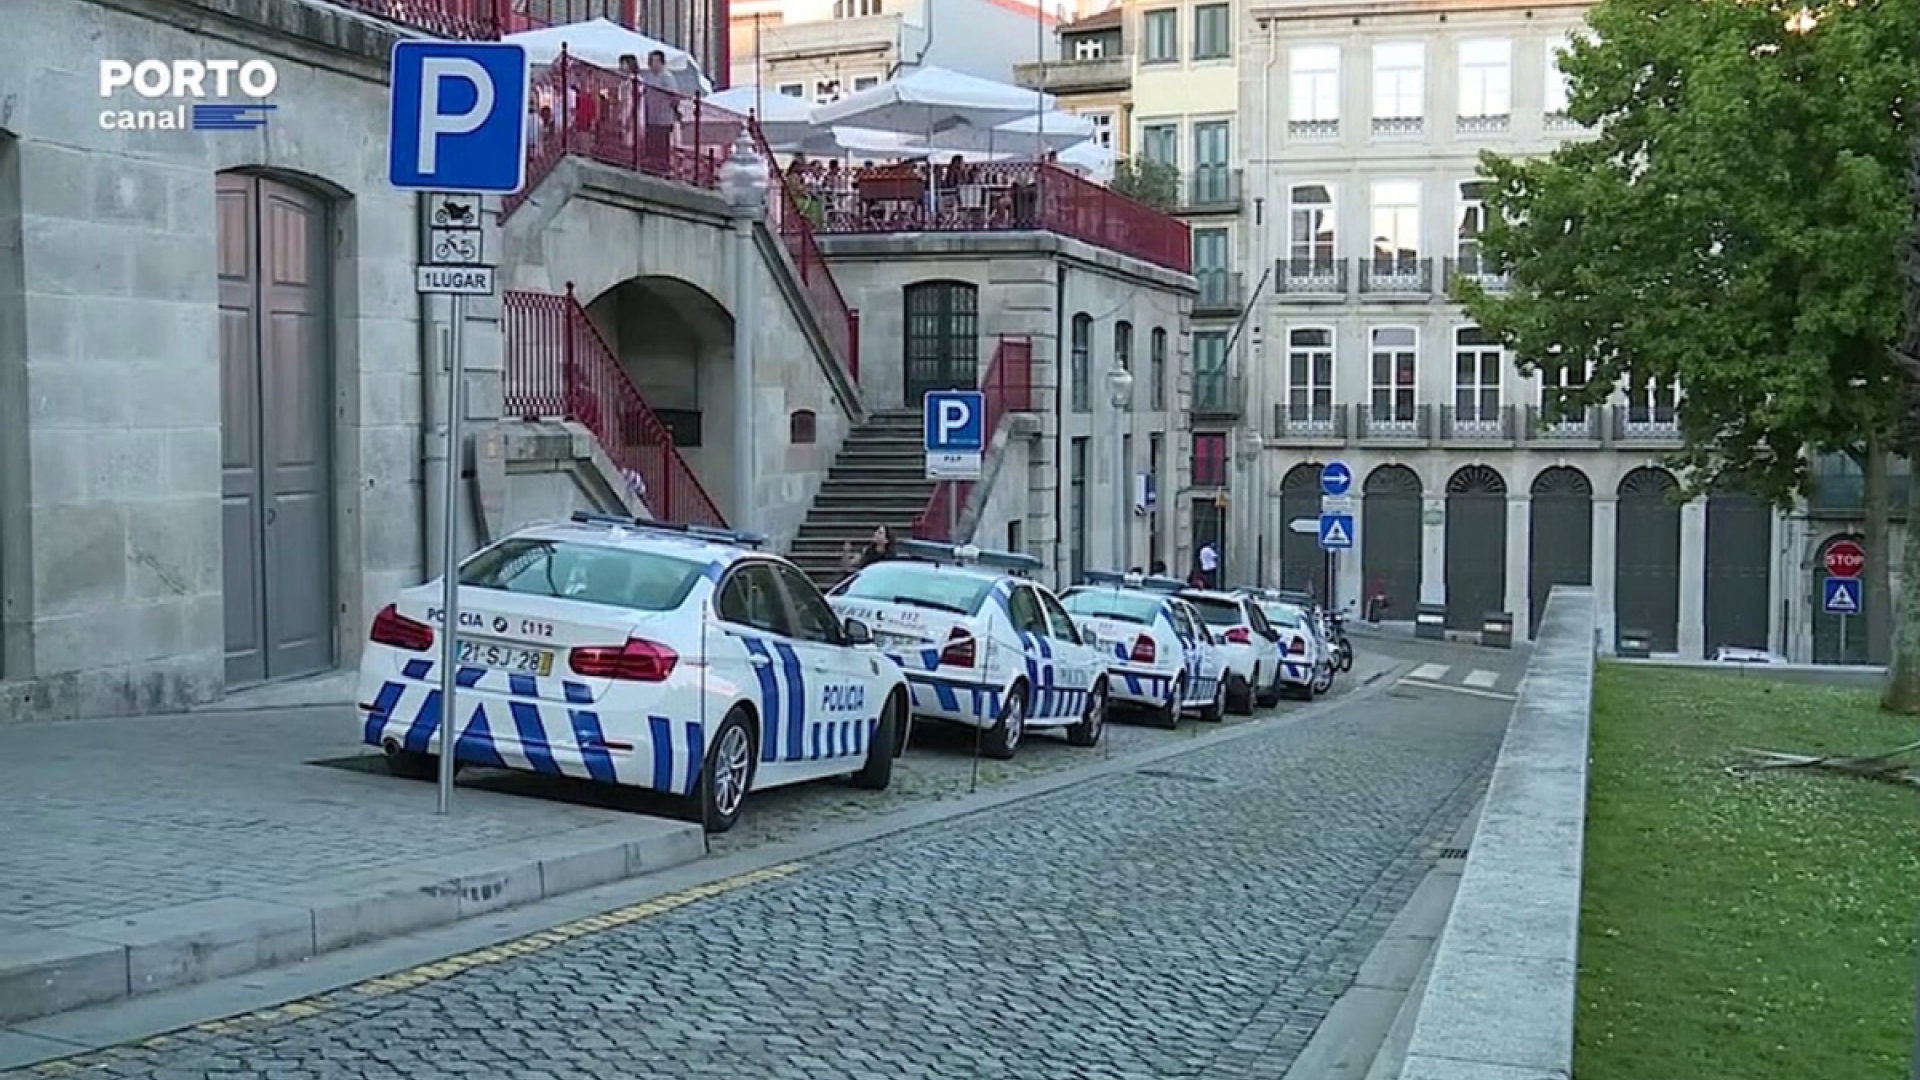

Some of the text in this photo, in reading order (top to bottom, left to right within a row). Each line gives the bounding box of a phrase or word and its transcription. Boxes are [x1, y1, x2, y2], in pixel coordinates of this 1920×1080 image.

[417, 56, 495, 175] P
[939, 398, 970, 445] P
[1826, 554, 1864, 567] STOP
[427, 608, 554, 637] POCIA 112
[461, 642, 540, 671] 21-SJ-28
